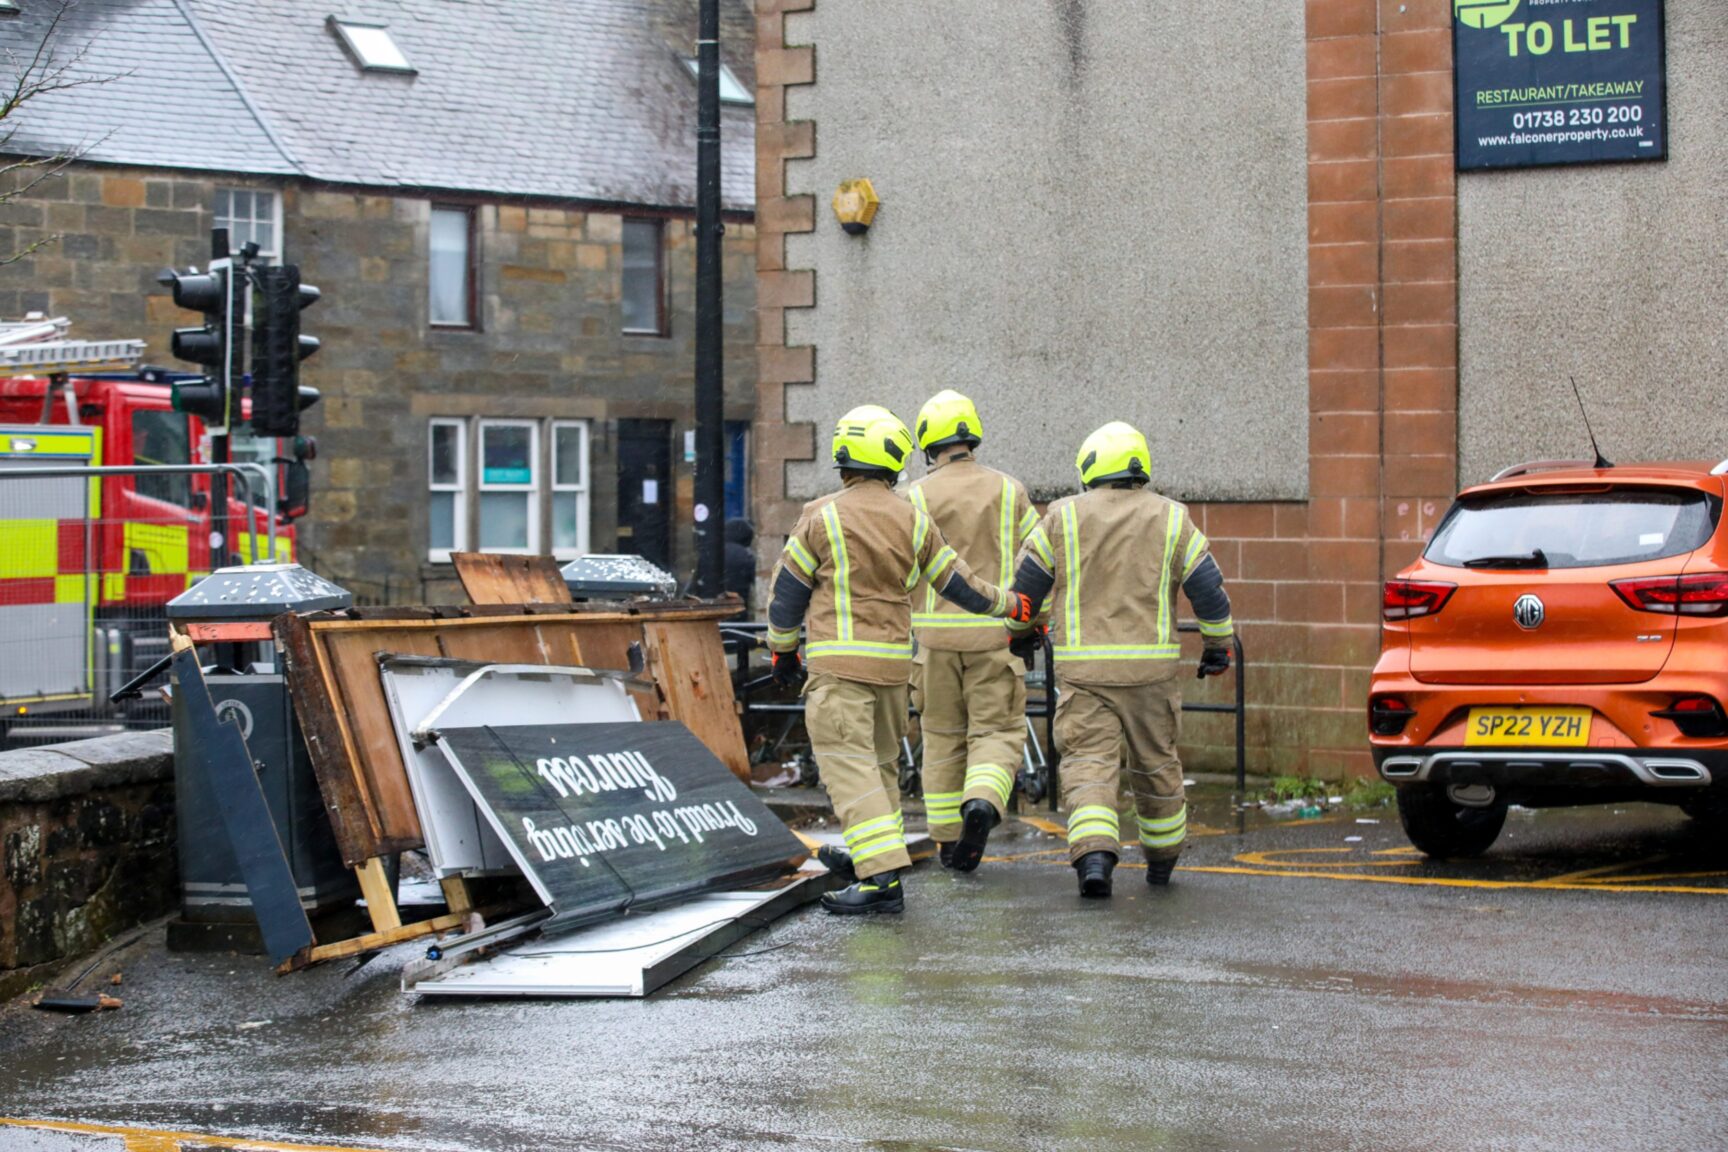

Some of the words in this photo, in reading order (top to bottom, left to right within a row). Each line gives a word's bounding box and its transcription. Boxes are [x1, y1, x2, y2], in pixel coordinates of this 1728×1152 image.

[1501, 21, 1553, 56] TO
[1564, 14, 1637, 52] LET
[1476, 80, 1644, 104] RESTAURANT/TAKEAWAY
[1513, 110, 1565, 129] 01738
[1569, 107, 1603, 126] 230
[1607, 105, 1642, 123] 200
[1478, 126, 1643, 146] www.falconerproperty.co.uk
[1516, 598, 1541, 626] MG
[1477, 715, 1533, 736] SP22
[1540, 716, 1582, 737] YZH
[537, 750, 677, 802] Kinross
[622, 814, 666, 851] be
[652, 807, 691, 843] to
[674, 800, 758, 843] Proud
[522, 816, 628, 867] serving
